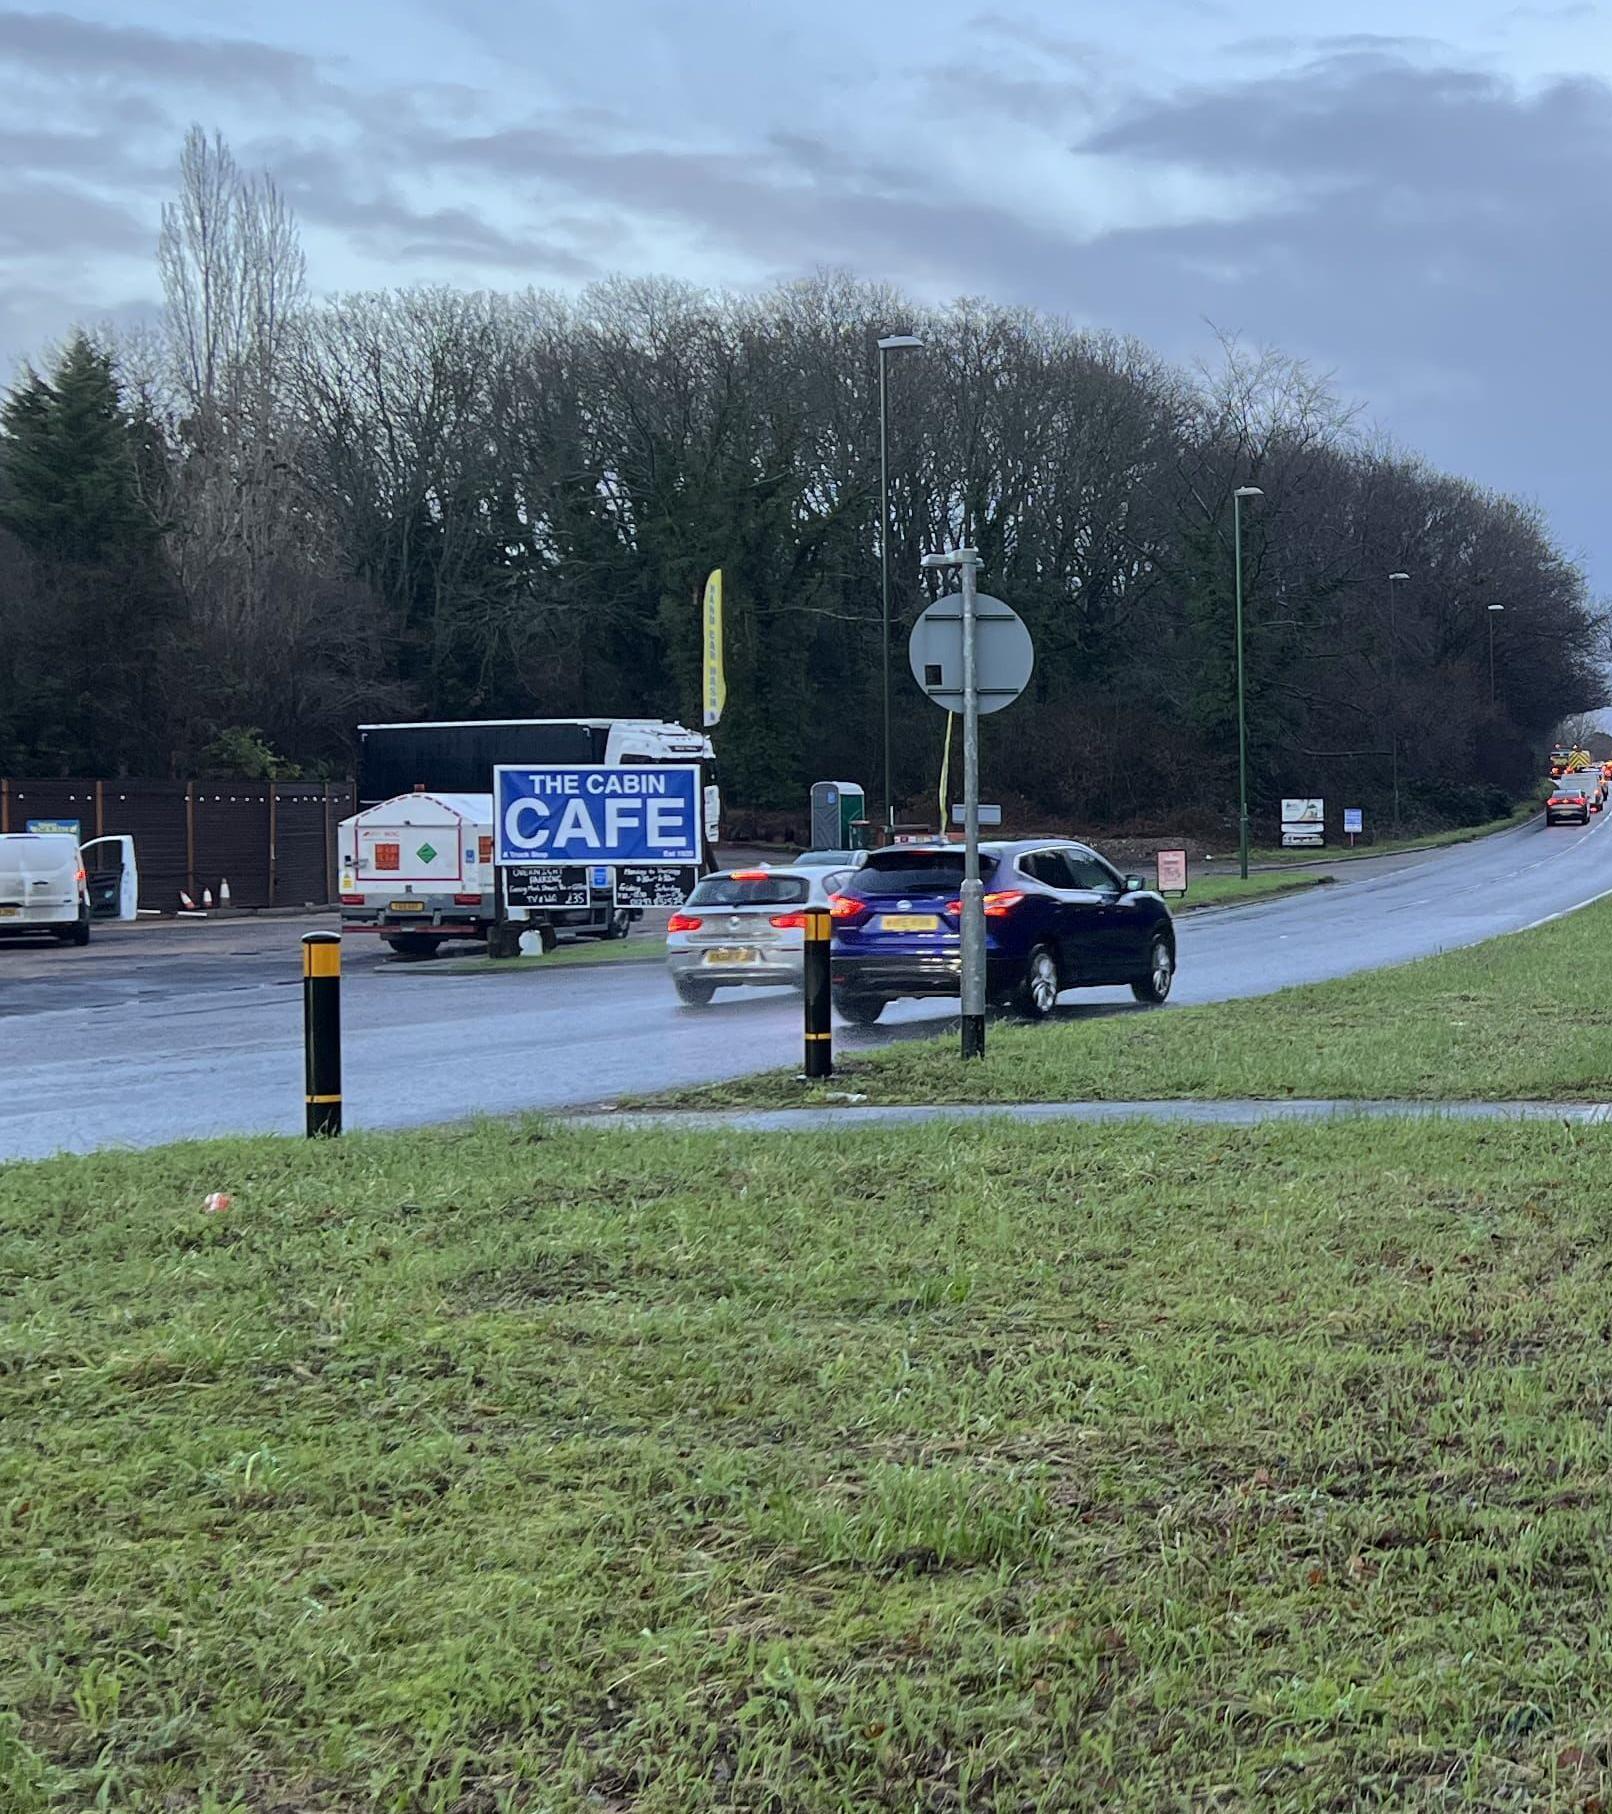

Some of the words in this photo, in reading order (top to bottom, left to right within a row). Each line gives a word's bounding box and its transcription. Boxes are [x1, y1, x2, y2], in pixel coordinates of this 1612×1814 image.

[529, 775, 579, 794] THE
[586, 774, 665, 794] CABIN
[505, 797, 687, 849] CAFE
[565, 892, 585, 904] £35
